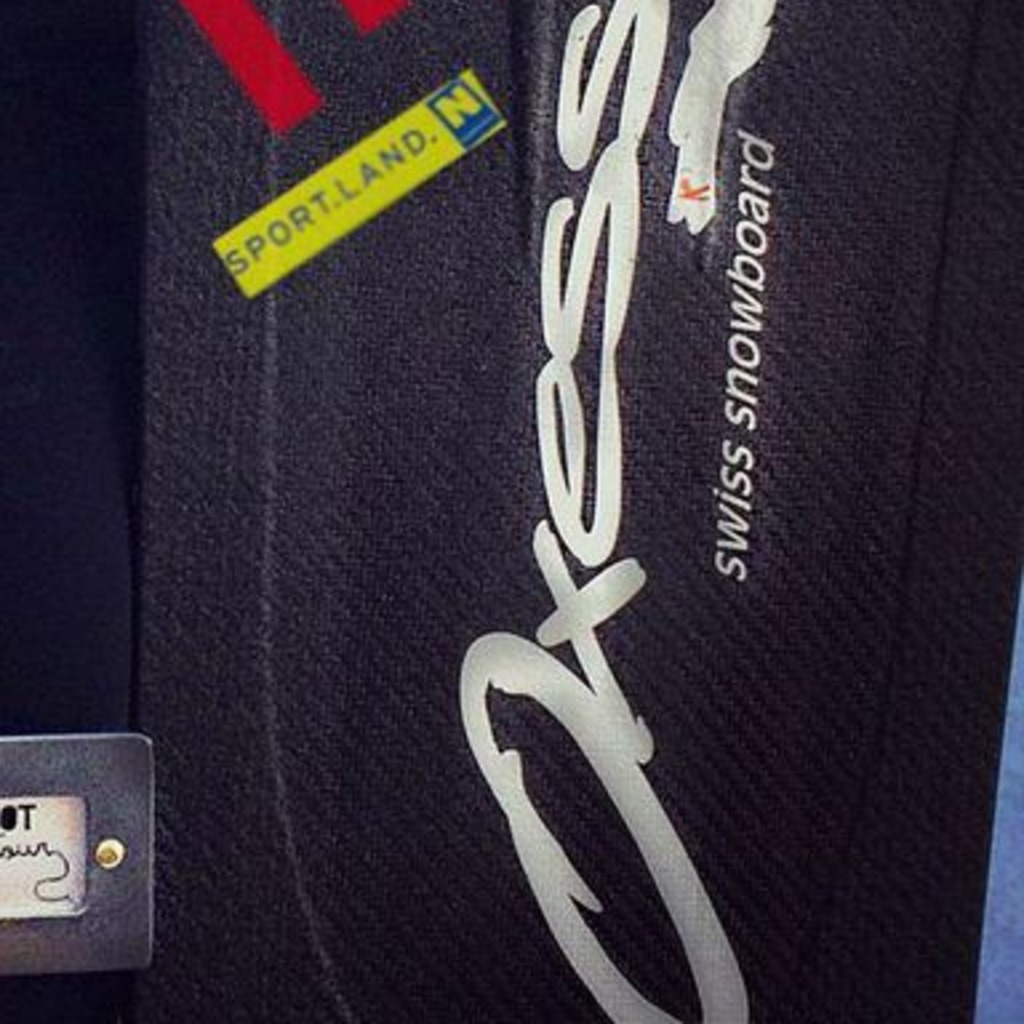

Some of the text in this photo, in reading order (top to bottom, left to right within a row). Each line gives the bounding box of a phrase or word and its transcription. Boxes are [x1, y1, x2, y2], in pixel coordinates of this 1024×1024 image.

[224, 127, 439, 277] SPORT.LAND.
[715, 129, 777, 582] swiss snowboard
